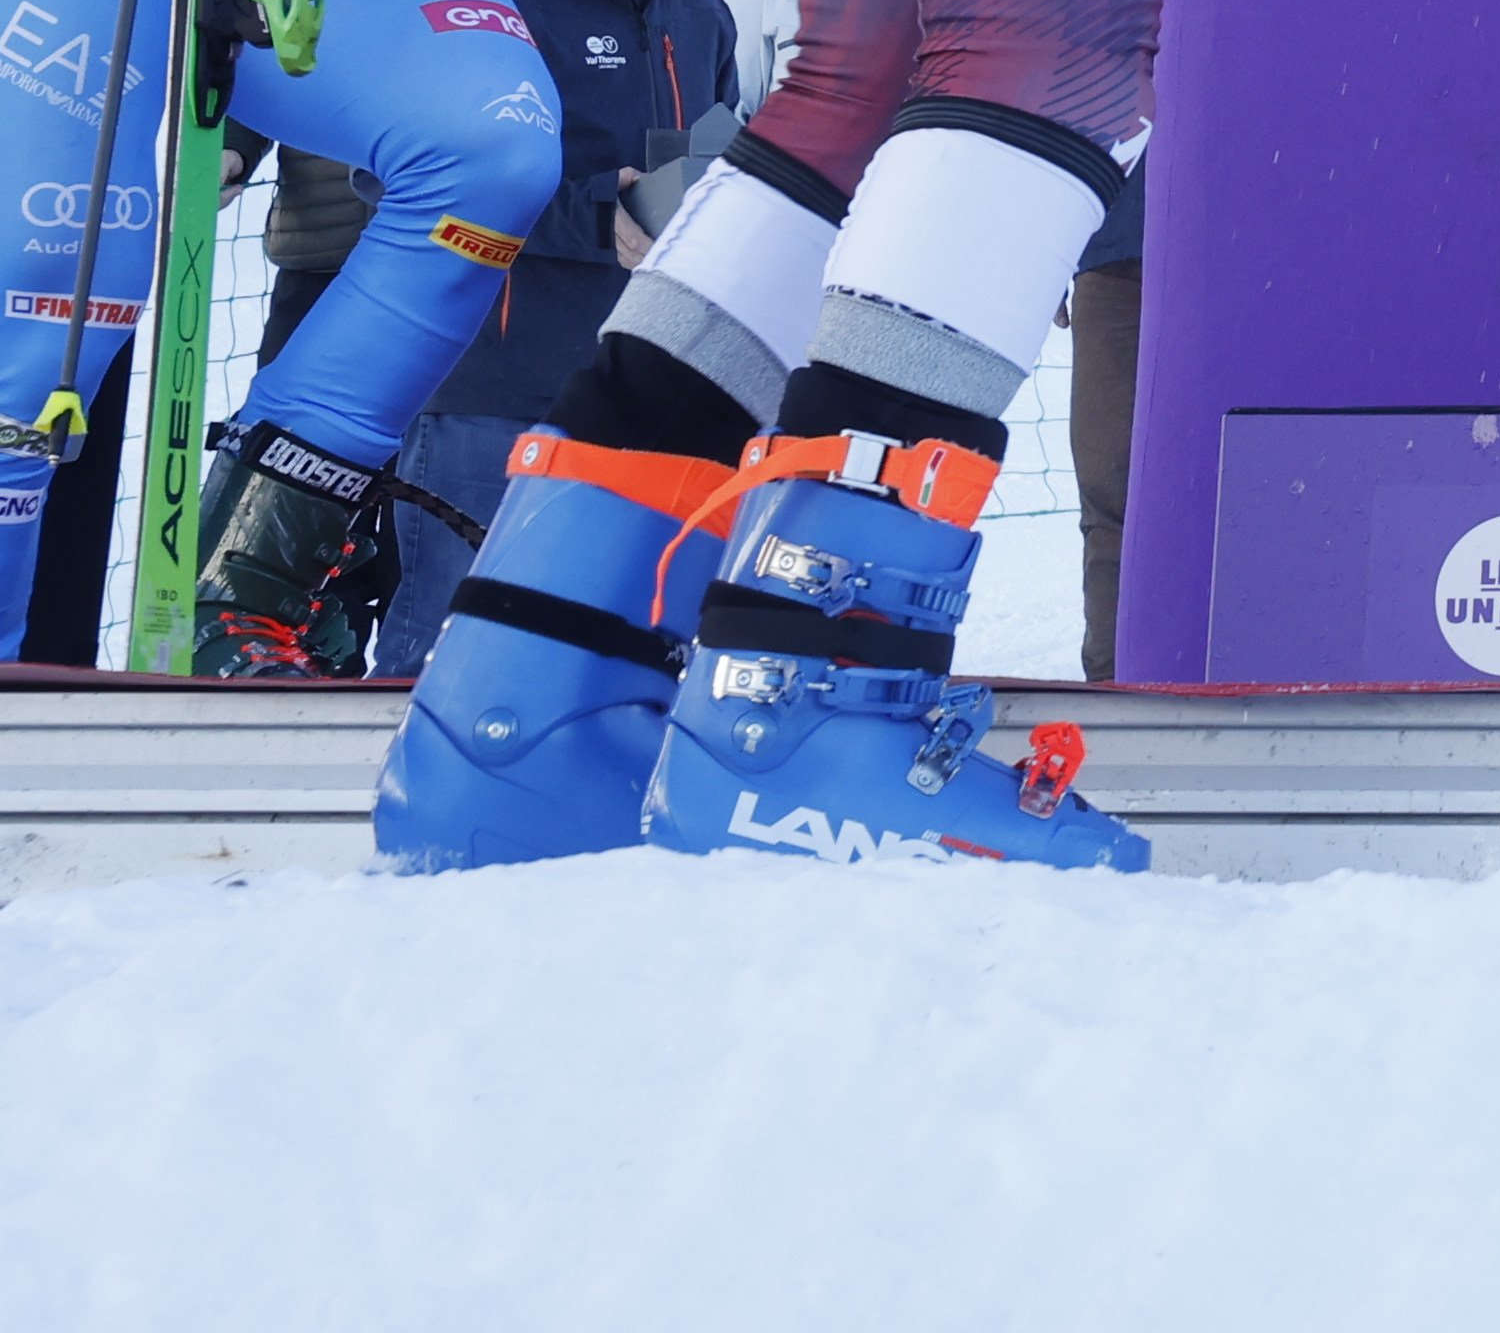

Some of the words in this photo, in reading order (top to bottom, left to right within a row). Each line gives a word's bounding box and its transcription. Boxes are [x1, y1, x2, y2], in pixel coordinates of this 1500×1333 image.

[0, 60, 48, 98] MPORIO
[493, 104, 557, 135] AVIO
[22, 237, 84, 255] Aud
[258, 435, 373, 504] BOOSTER
